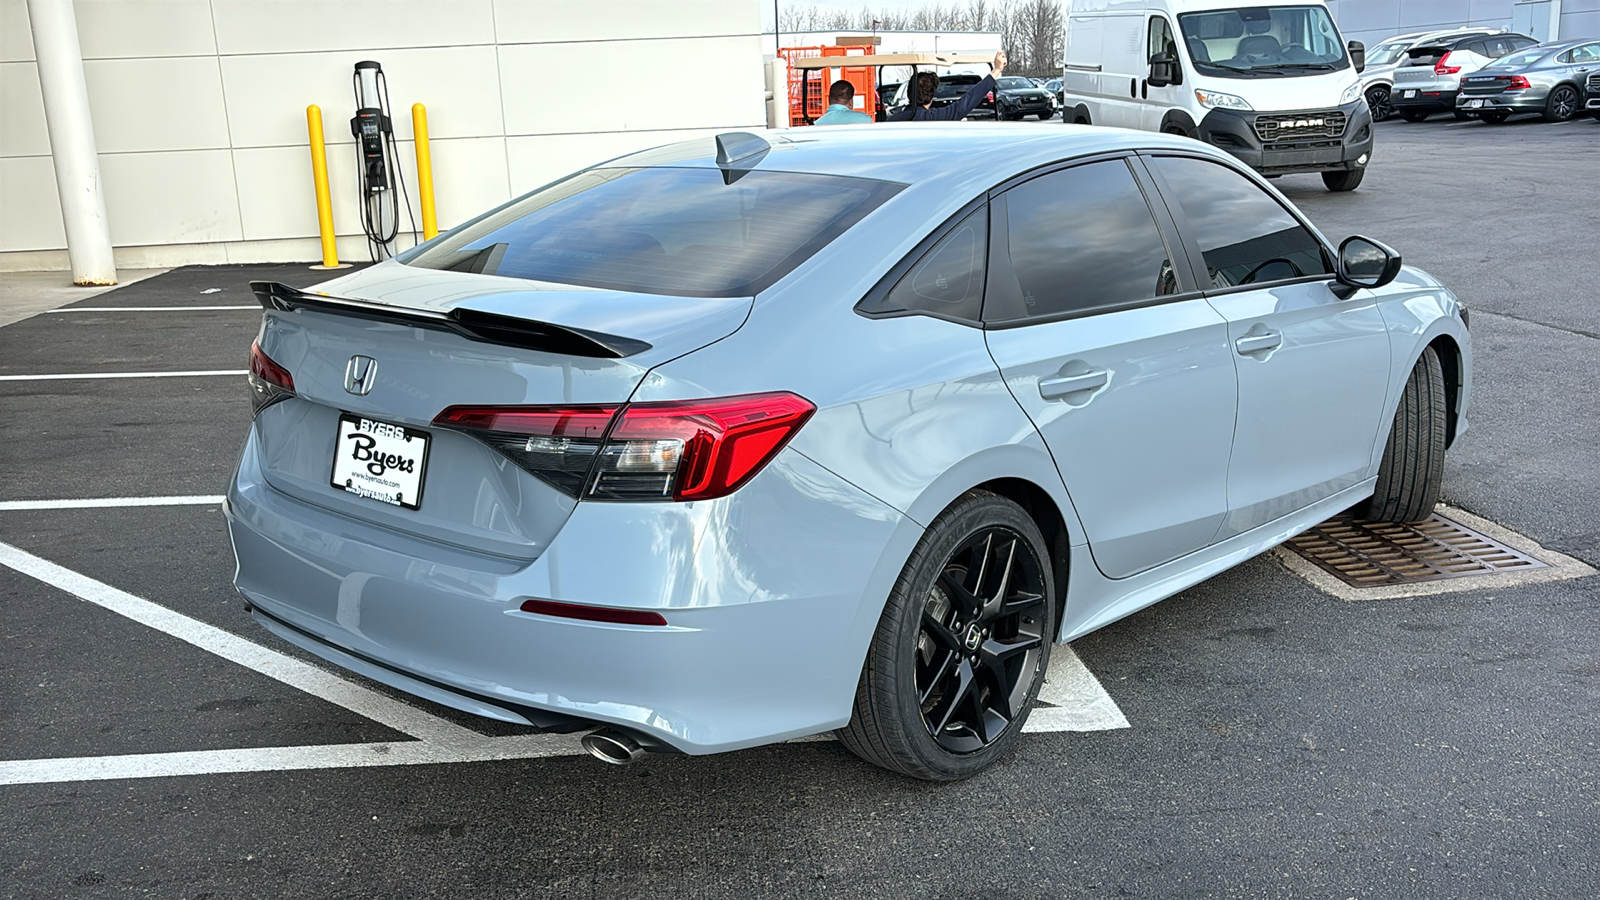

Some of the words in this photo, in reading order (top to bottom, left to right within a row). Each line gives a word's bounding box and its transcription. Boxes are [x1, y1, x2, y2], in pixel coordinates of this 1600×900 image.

[1280, 119, 1324, 129] RAM
[360, 418, 405, 440] BYERS
[347, 433, 414, 476] Byers
[351, 471, 401, 489] www.byersauto.com
